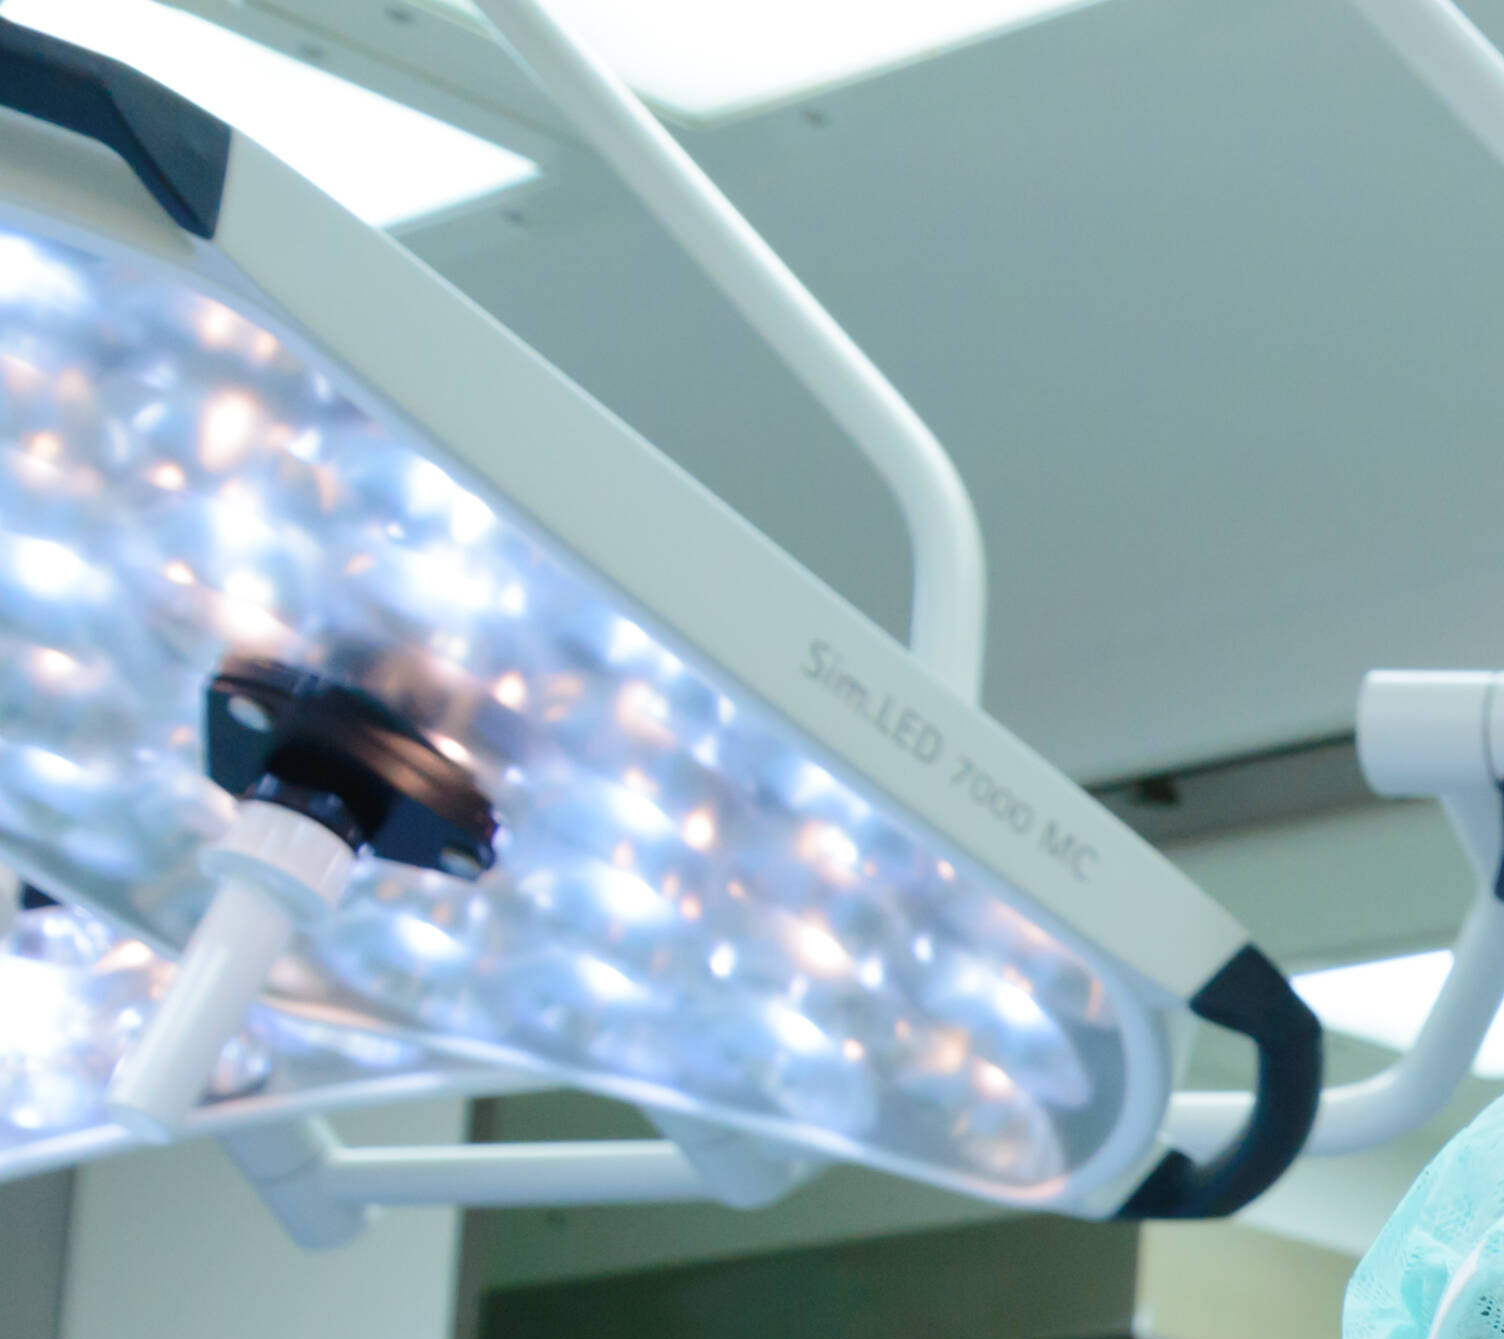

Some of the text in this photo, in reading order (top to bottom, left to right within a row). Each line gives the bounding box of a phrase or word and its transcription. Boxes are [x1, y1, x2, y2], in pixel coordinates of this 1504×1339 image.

[799, 637, 1102, 884] Sim.LED 7000 MC
